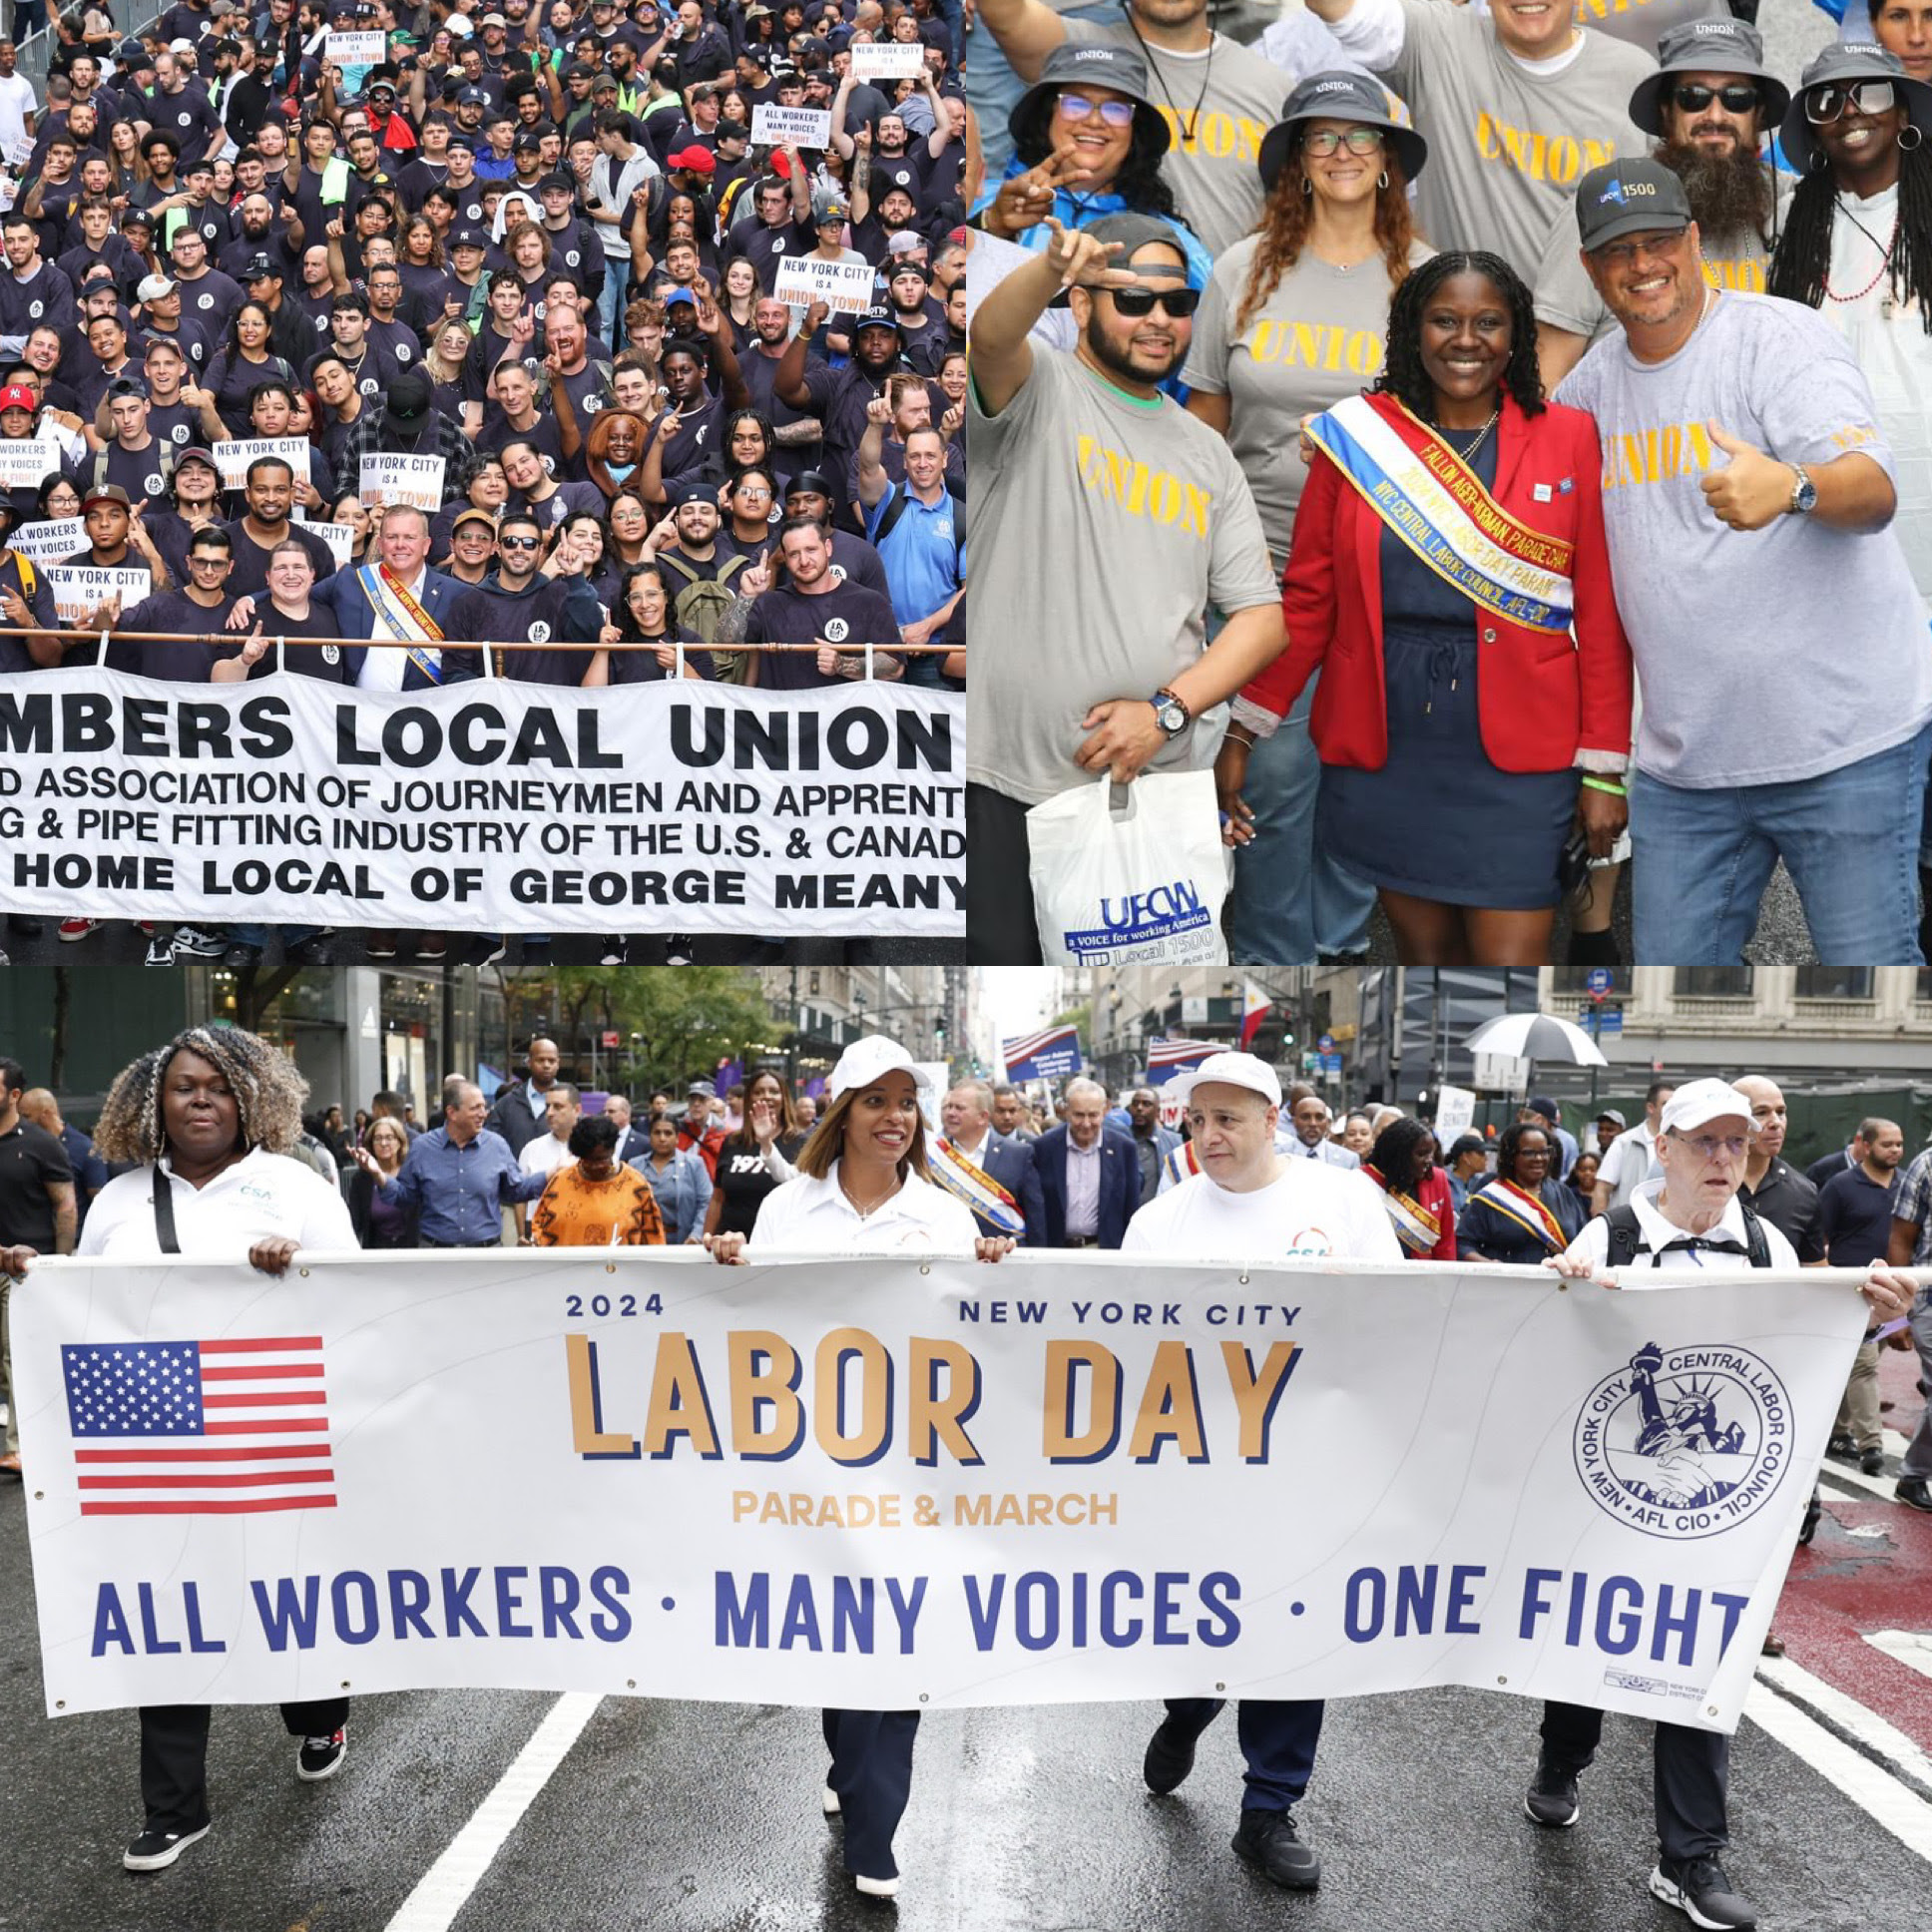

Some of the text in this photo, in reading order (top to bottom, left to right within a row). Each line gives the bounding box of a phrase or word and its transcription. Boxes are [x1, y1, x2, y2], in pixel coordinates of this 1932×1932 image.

[328, 34, 343, 43] NEW
[1695, 24, 1735, 36] UNION
[856, 46, 920, 55] NEW YORK CITY
[1075, 50, 1114, 62] UNION
[1844, 44, 1883, 56] UNION
[1315, 80, 1354, 93] UNION
[764, 110, 820, 123] ALL WORKERS
[766, 122, 816, 134] MANY VOICES
[1477, 110, 1616, 184] UNION
[1623, 183, 1656, 197] 1500
[783, 259, 871, 281] NEW YORK CITY
[815, 279, 824, 288] IS
[779, 288, 868, 312] UNION TOWN
[867, 305, 888, 315] OTTO
[1250, 318, 1384, 377] UNIO
[218, 440, 304, 456] NEW YORK CITY
[1602, 421, 1712, 490] UNION
[11, 459, 43, 469] VOICES
[362, 457, 439, 473] NEW YORK CITY
[1419, 442, 1460, 486] FALLON
[381, 474, 398, 484] IS A
[1077, 434, 1214, 541] UNION
[397, 490, 438, 508] TOWN
[26, 523, 77, 540] WORKERS
[321, 526, 348, 540] CITY
[1390, 499, 1432, 547] CENTRAL
[1427, 537, 1466, 577] LABOR
[13, 540, 76, 556] MANY VOICES
[47, 569, 145, 586] NEW YORK CITY
[86, 589, 104, 599] IS A
[336, 703, 624, 769] LOCAL
[670, 704, 952, 772] UNION
[34, 766, 305, 805] ASSOCIATION
[317, 775, 371, 809] OF
[381, 779, 663, 813] JOURNEYMEN
[675, 780, 761, 813] AND
[773, 782, 966, 818] APPRENT
[37, 809, 63, 839] &
[78, 808, 159, 842] PIPE
[172, 813, 322, 846] FITTING
[333, 817, 530, 854] INDUSTRY
[540, 822, 594, 855] OF
[606, 822, 684, 855] THE
[696, 823, 771, 858] U.S.
[785, 827, 811, 859] &
[825, 825, 966, 860] CANAD
[14, 852, 966, 911] HOME LOCAL OF GEORGE MEANY
[1100, 879, 1200, 930] UFCW
[1068, 911, 1210, 947] a VOICE for working America
[1114, 940, 1167, 966] Local
[1168, 927, 1214, 956] 1500
[729, 1155, 772, 1174] 197
[566, 1293, 664, 1317] 2024
[960, 1300, 1301, 1327] NEW YORK CITY
[566, 1327, 1303, 1468] LABOR DAY
[1582, 1352, 1786, 1517] NEW YORK CITY CENTRAL LABOR COUNCIL
[731, 1490, 1119, 1529] PARADE & MARCH
[1631, 1506, 1711, 1532] AFL CIO
[91, 1564, 1749, 1667] ALL WORKERS MANY VOICES ONE FIGHT
